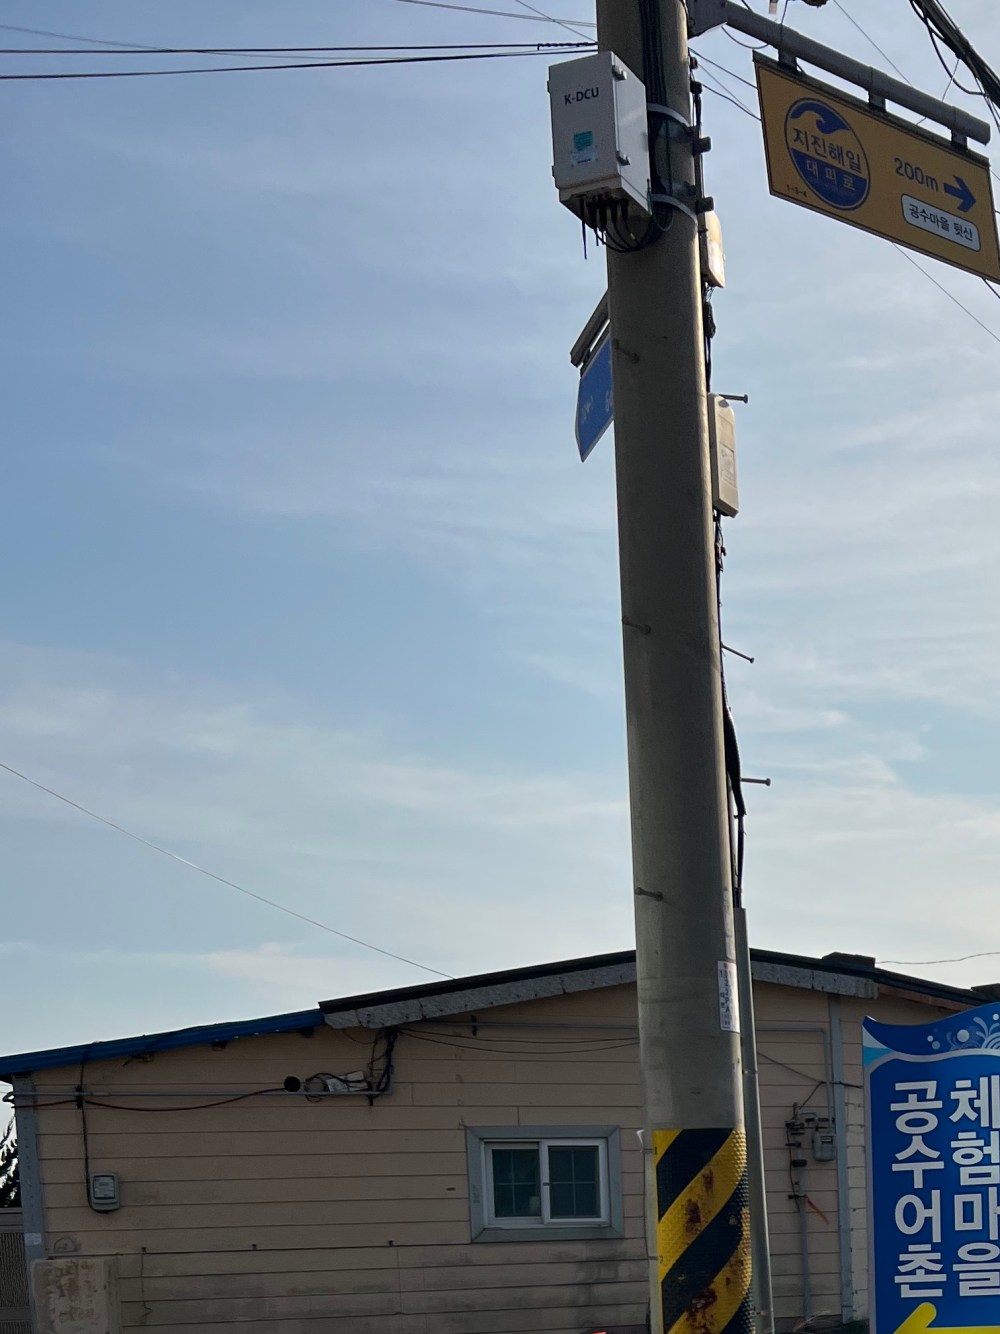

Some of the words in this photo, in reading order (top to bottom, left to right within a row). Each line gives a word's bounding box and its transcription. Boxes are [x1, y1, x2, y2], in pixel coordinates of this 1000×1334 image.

[564, 87, 600, 105] K-DCU
[793, 127, 863, 175] 지진해일
[893, 157, 939, 192] 200m
[909, 203, 950, 232] 공수마을
[953, 222, 974, 242] 뒷산
[890, 1079, 948, 1298] 공수어촌
